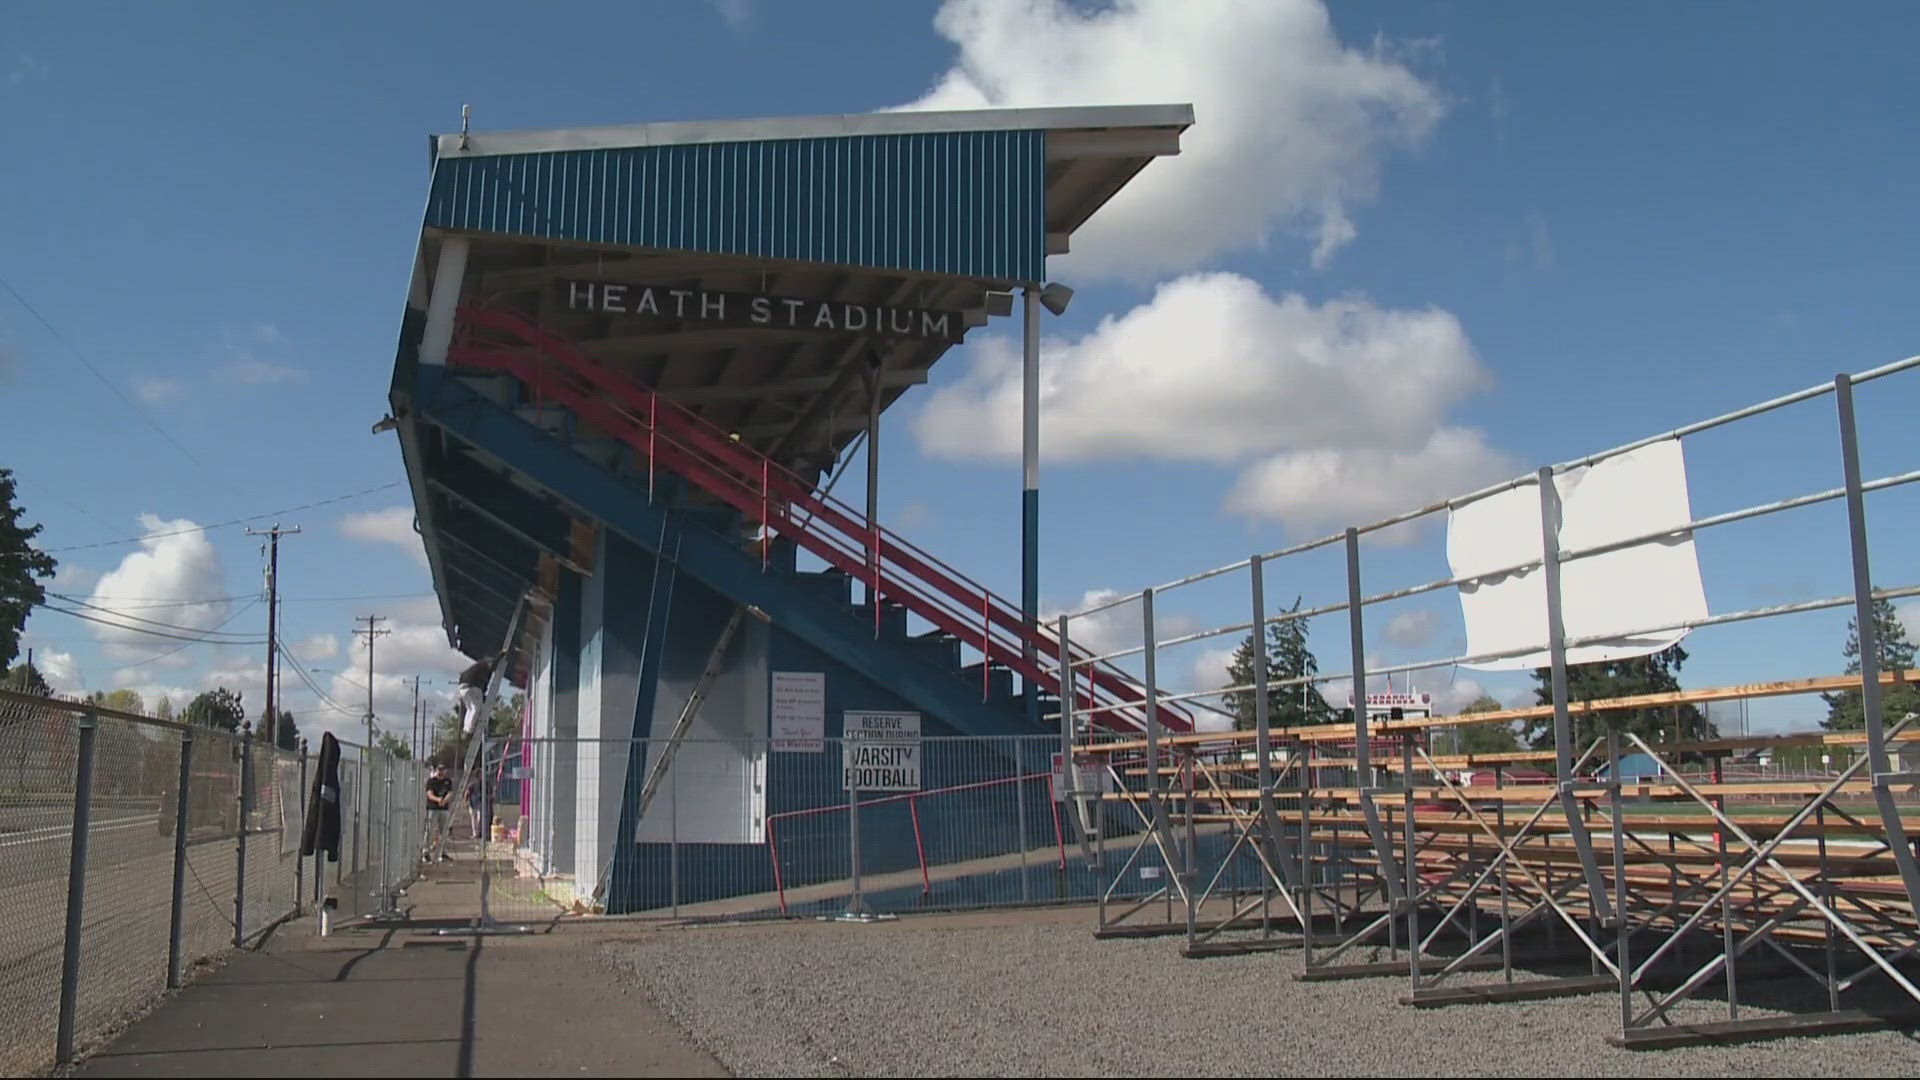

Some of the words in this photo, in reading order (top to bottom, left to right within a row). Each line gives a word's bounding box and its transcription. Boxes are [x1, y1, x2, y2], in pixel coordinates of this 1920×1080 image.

[569, 281, 726, 320] HEATH
[749, 296, 950, 337] STADIUM
[862, 716, 903, 729] RESERVE
[846, 729, 883, 740] SECTION
[845, 768, 919, 787] FOOTBALL
